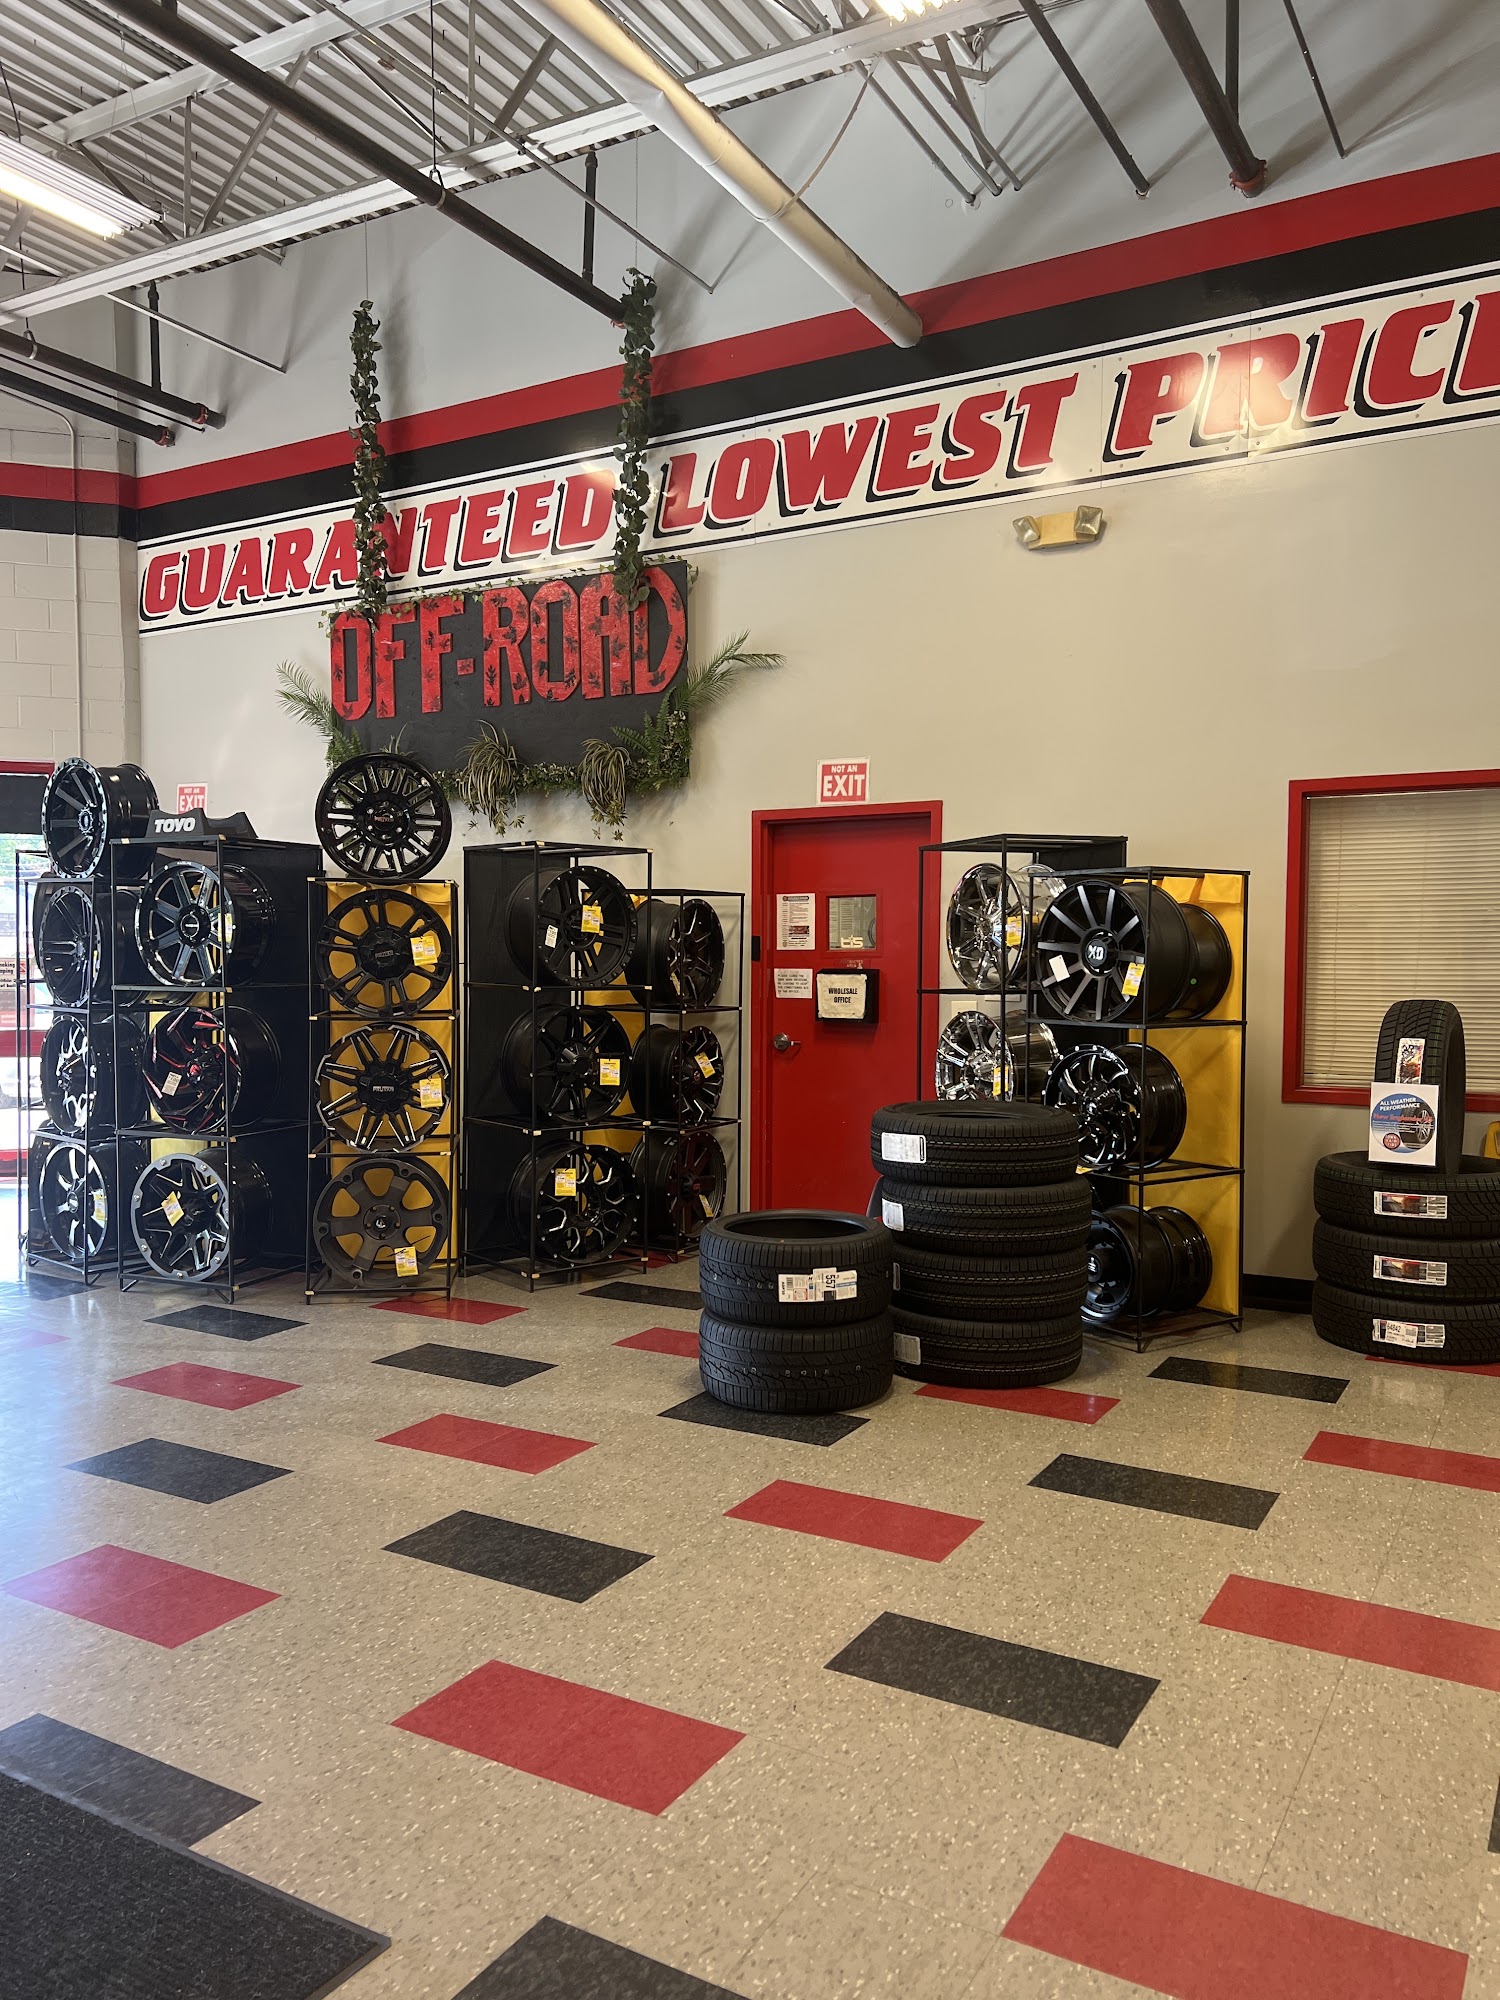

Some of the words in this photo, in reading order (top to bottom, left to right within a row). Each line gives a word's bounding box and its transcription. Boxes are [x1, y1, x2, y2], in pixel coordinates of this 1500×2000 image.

[140, 468, 618, 622] GUARANTEED
[653, 371, 1079, 539] LOWEST
[330, 565, 687, 721] OFF-ROAD
[831, 765, 845, 773] NOT
[847, 764, 858, 773] AN
[823, 774, 865, 797] EXIT
[180, 795, 204, 811] EXIT
[154, 817, 196, 833] TOYO
[1088, 944, 1104, 961] XD
[1380, 1103, 1421, 1111] PERFORMANCE
[825, 1274, 836, 1289] 557
